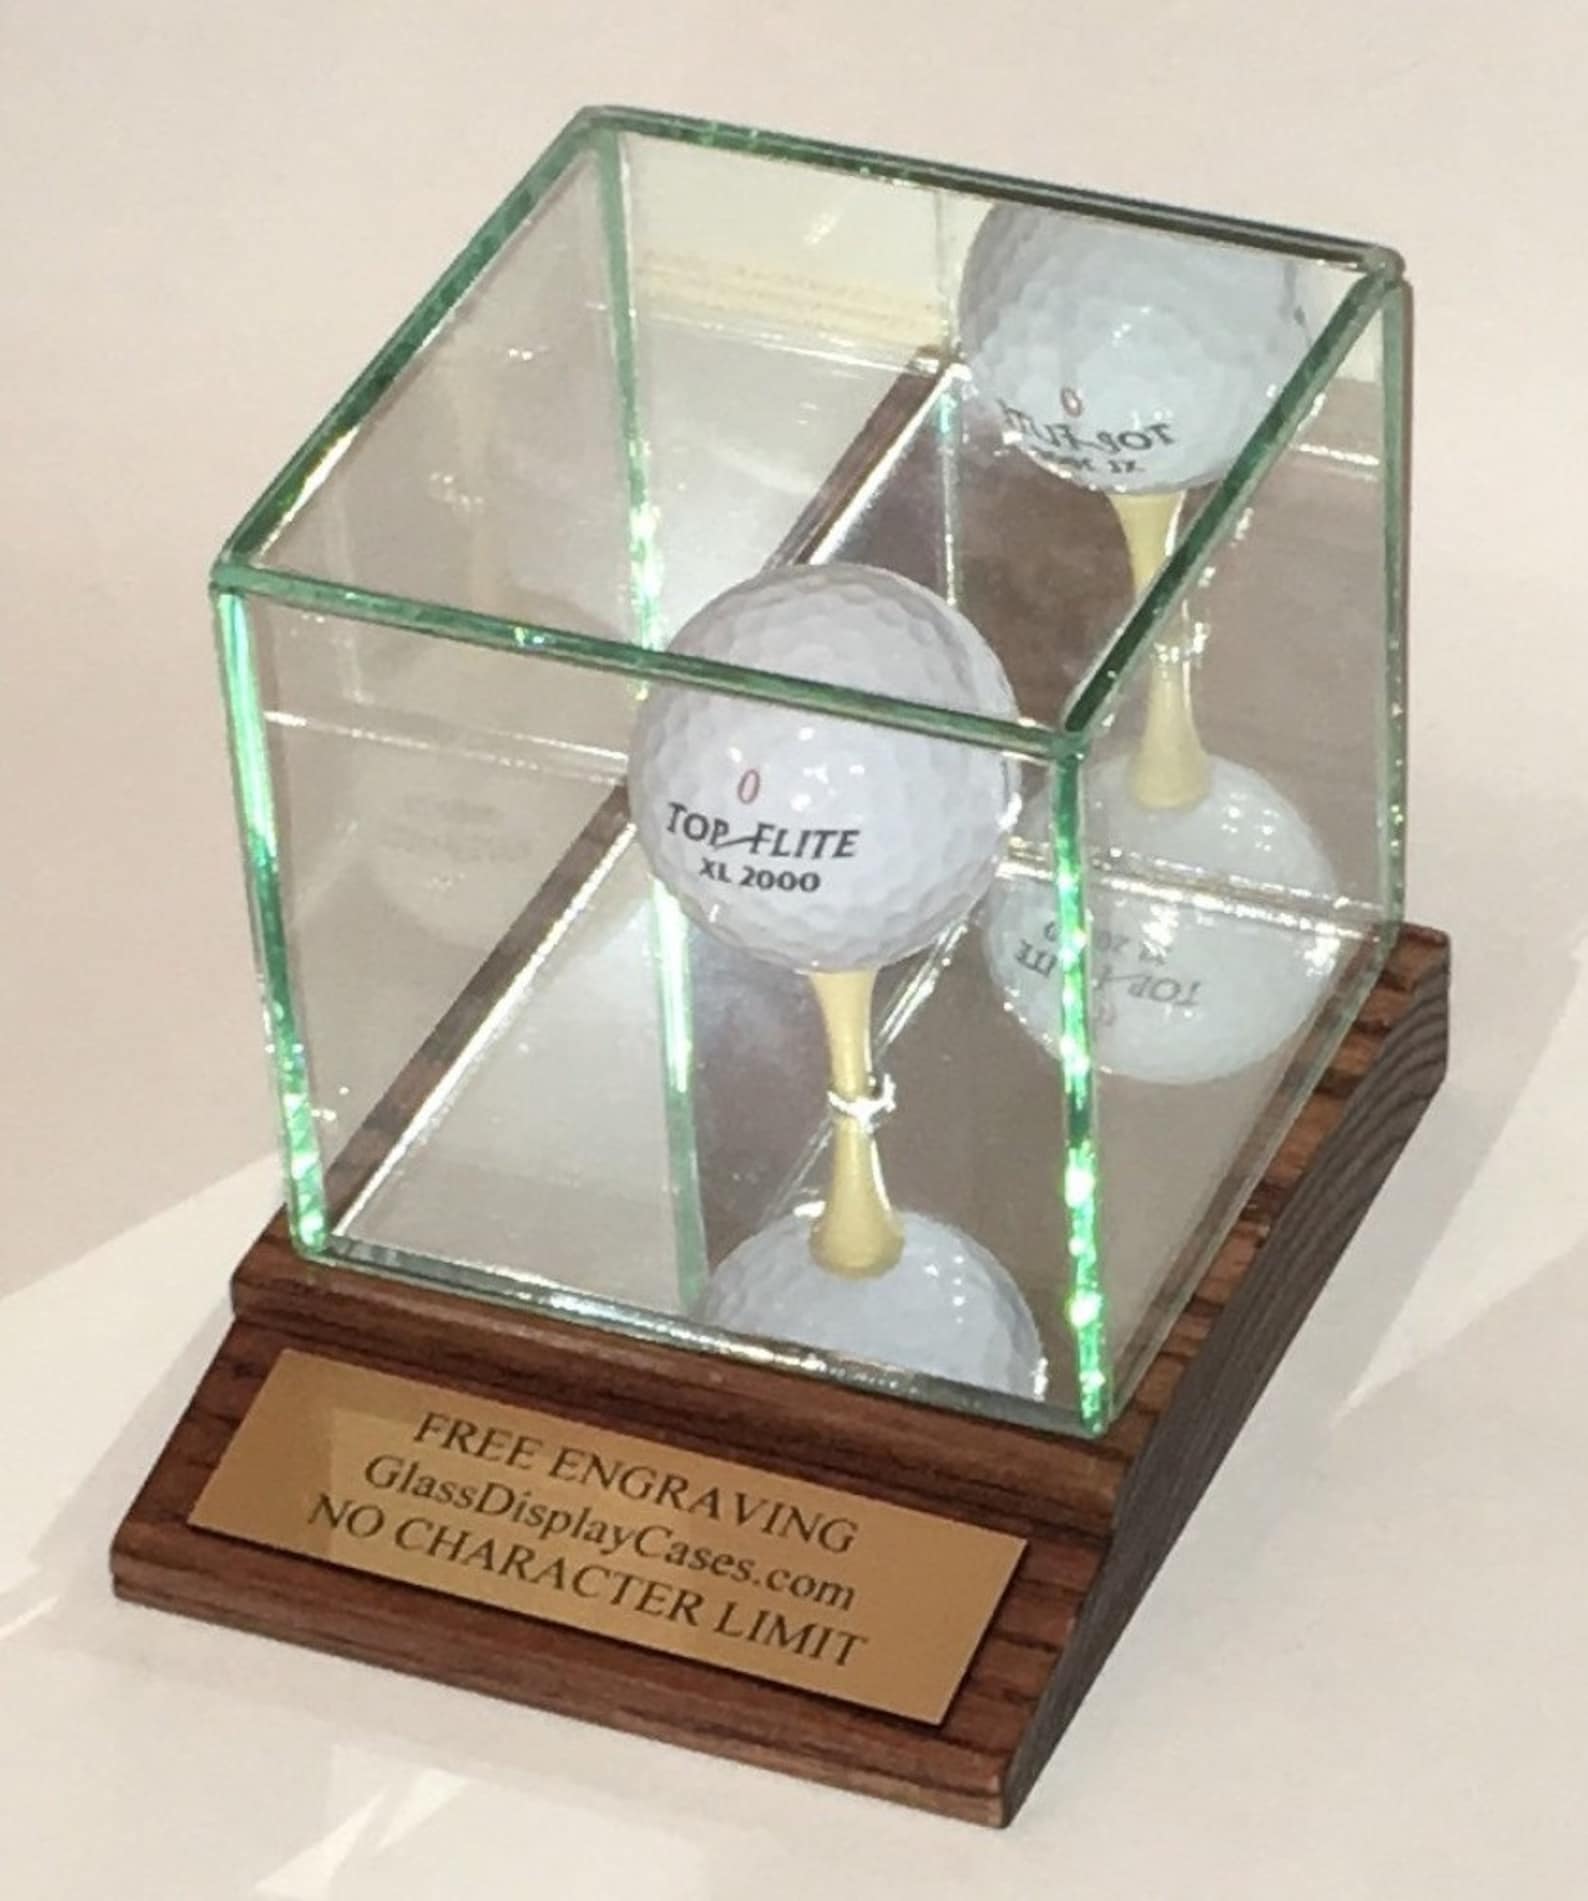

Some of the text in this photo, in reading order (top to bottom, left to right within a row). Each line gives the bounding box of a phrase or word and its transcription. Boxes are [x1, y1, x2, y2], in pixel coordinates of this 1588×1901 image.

[666, 800, 862, 859] TOP FLITE
[736, 768, 762, 805] 0
[699, 857, 822, 893] XL 2000
[364, 1454, 857, 1611] GlassDisplayCases.com
[412, 1410, 860, 1556] FREE ENGRAVING
[307, 1491, 870, 1668] NO CHARACTER LIMIT
